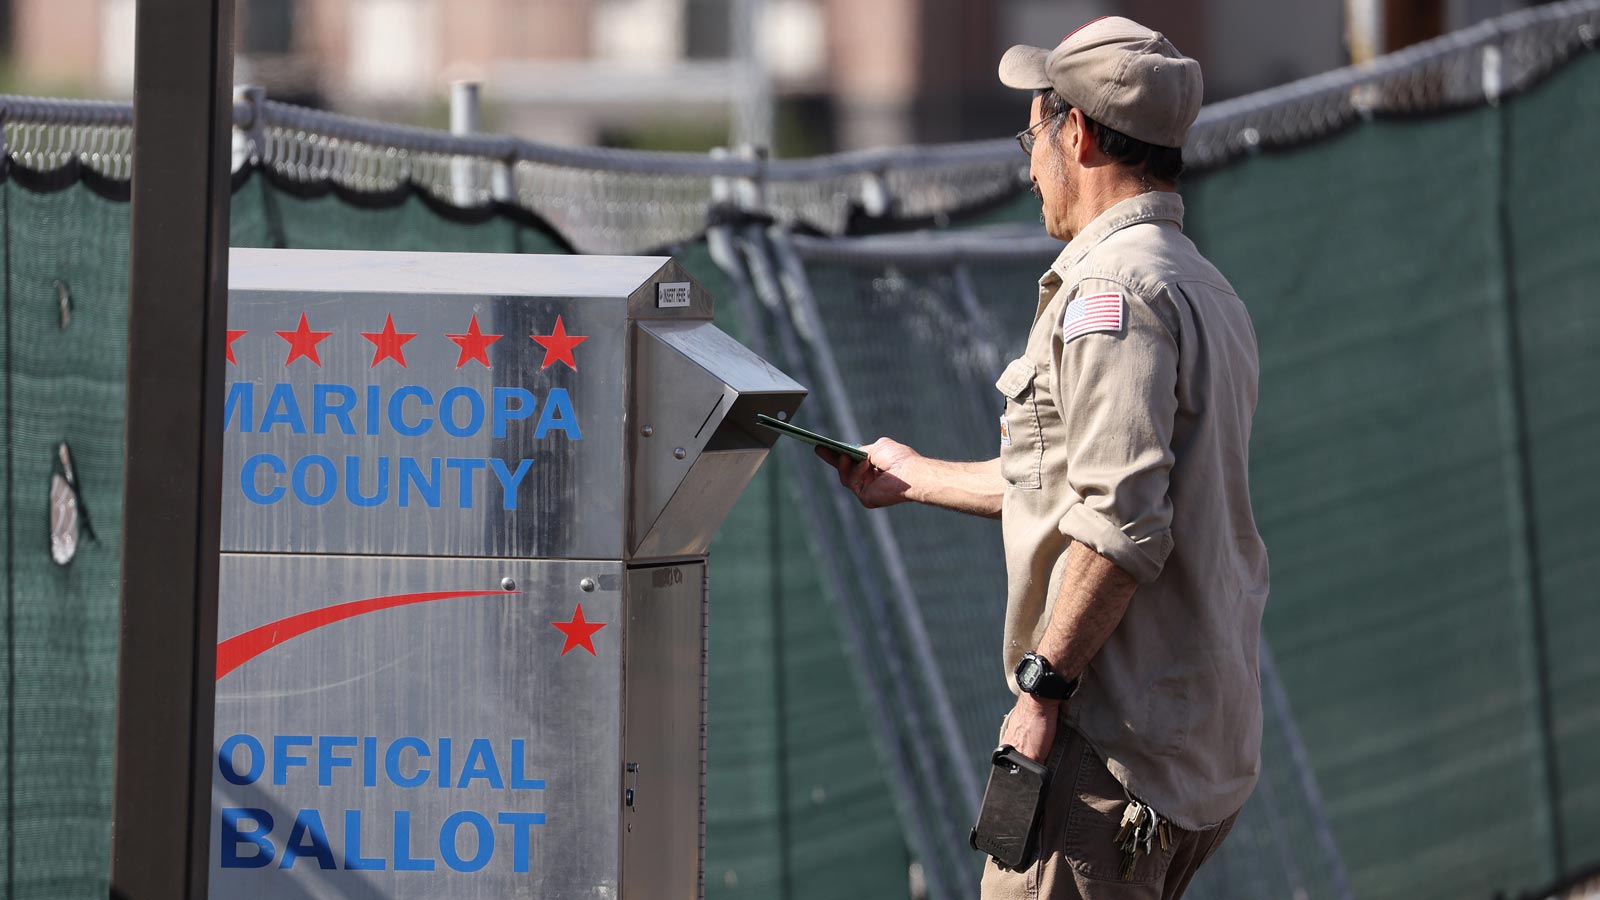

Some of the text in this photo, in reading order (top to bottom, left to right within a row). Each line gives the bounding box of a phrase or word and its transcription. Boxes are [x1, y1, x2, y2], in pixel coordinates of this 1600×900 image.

[240, 453, 535, 510] COUNTY
[218, 733, 546, 790] OFFICIAL
[220, 807, 547, 873] BALLOT
